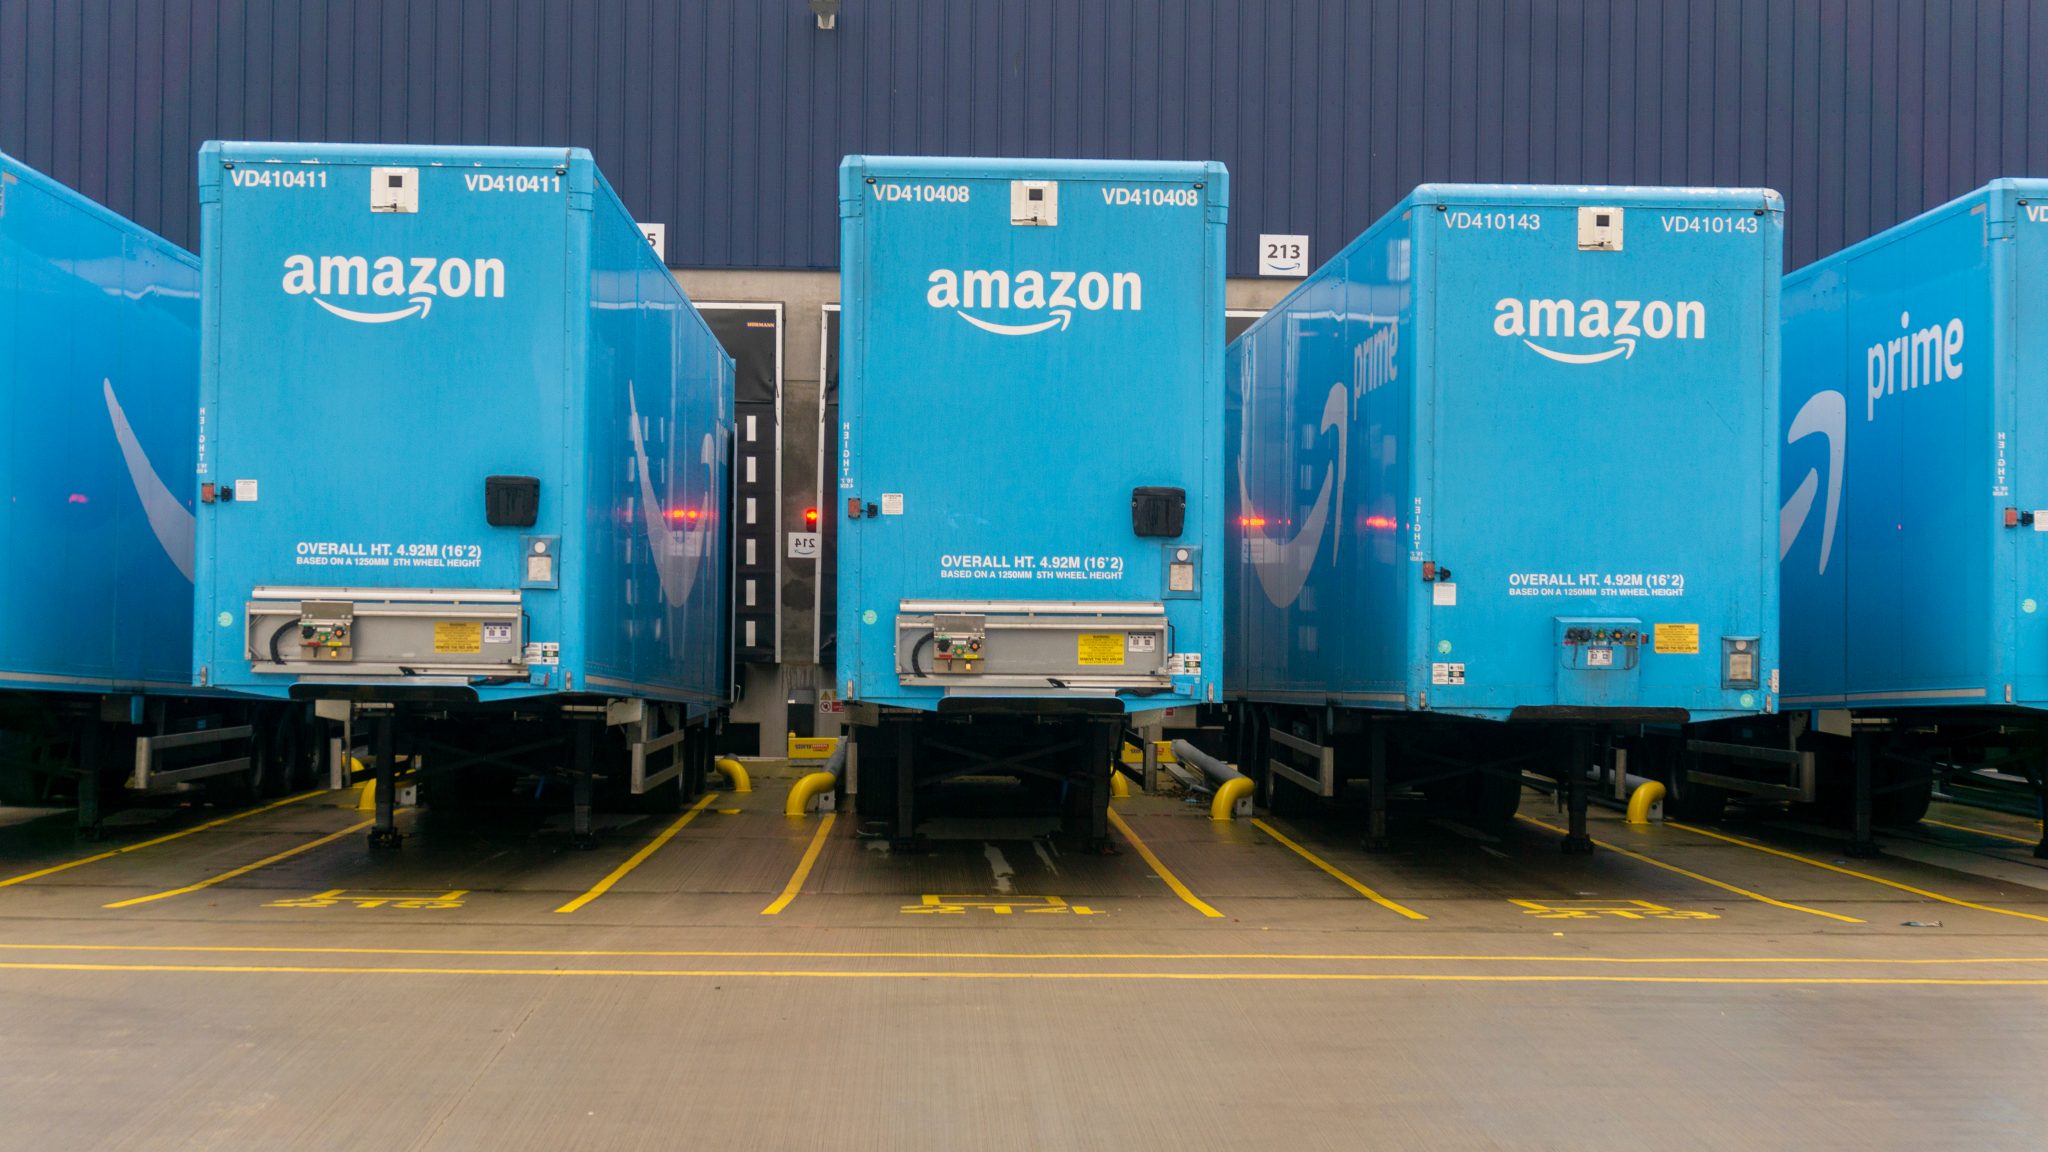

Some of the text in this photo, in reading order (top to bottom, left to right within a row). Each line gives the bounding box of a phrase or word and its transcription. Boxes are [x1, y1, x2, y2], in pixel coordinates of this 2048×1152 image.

[231, 169, 328, 189] VD410411
[465, 174, 561, 194] VD410411
[872, 184, 970, 203] VD410408
[1102, 187, 1199, 207] VD410408
[1443, 212, 1541, 231] VD410143
[1661, 215, 1758, 234] VD410143
[1267, 243, 1301, 260] 213
[282, 254, 506, 299] amazon
[927, 268, 1142, 312] amazon
[1493, 297, 1706, 340] amazon
[1354, 312, 1398, 421] prime
[1867, 311, 1964, 421] prime
[296, 542, 367, 556] OVERALL
[371, 543, 393, 556] HT.
[396, 544, 438, 557] 4.92M
[296, 556, 481, 567] BASED ON A 1250MM 5TH WHEEL HEIGHT
[940, 555, 1011, 568] OVERALL
[1014, 555, 1036, 568] HT.
[1039, 556, 1081, 569] 4.92M
[940, 570, 1123, 580] BASED ON A 1250MM 5TH WHEEL HEIGHT
[1509, 573, 1576, 586] OVERALL
[1579, 574, 1601, 586] HT.
[1603, 574, 1643, 586] 4.92M
[1509, 588, 1684, 596] BASED ON A 1250MM 5TH WHEEL HEIGHT
